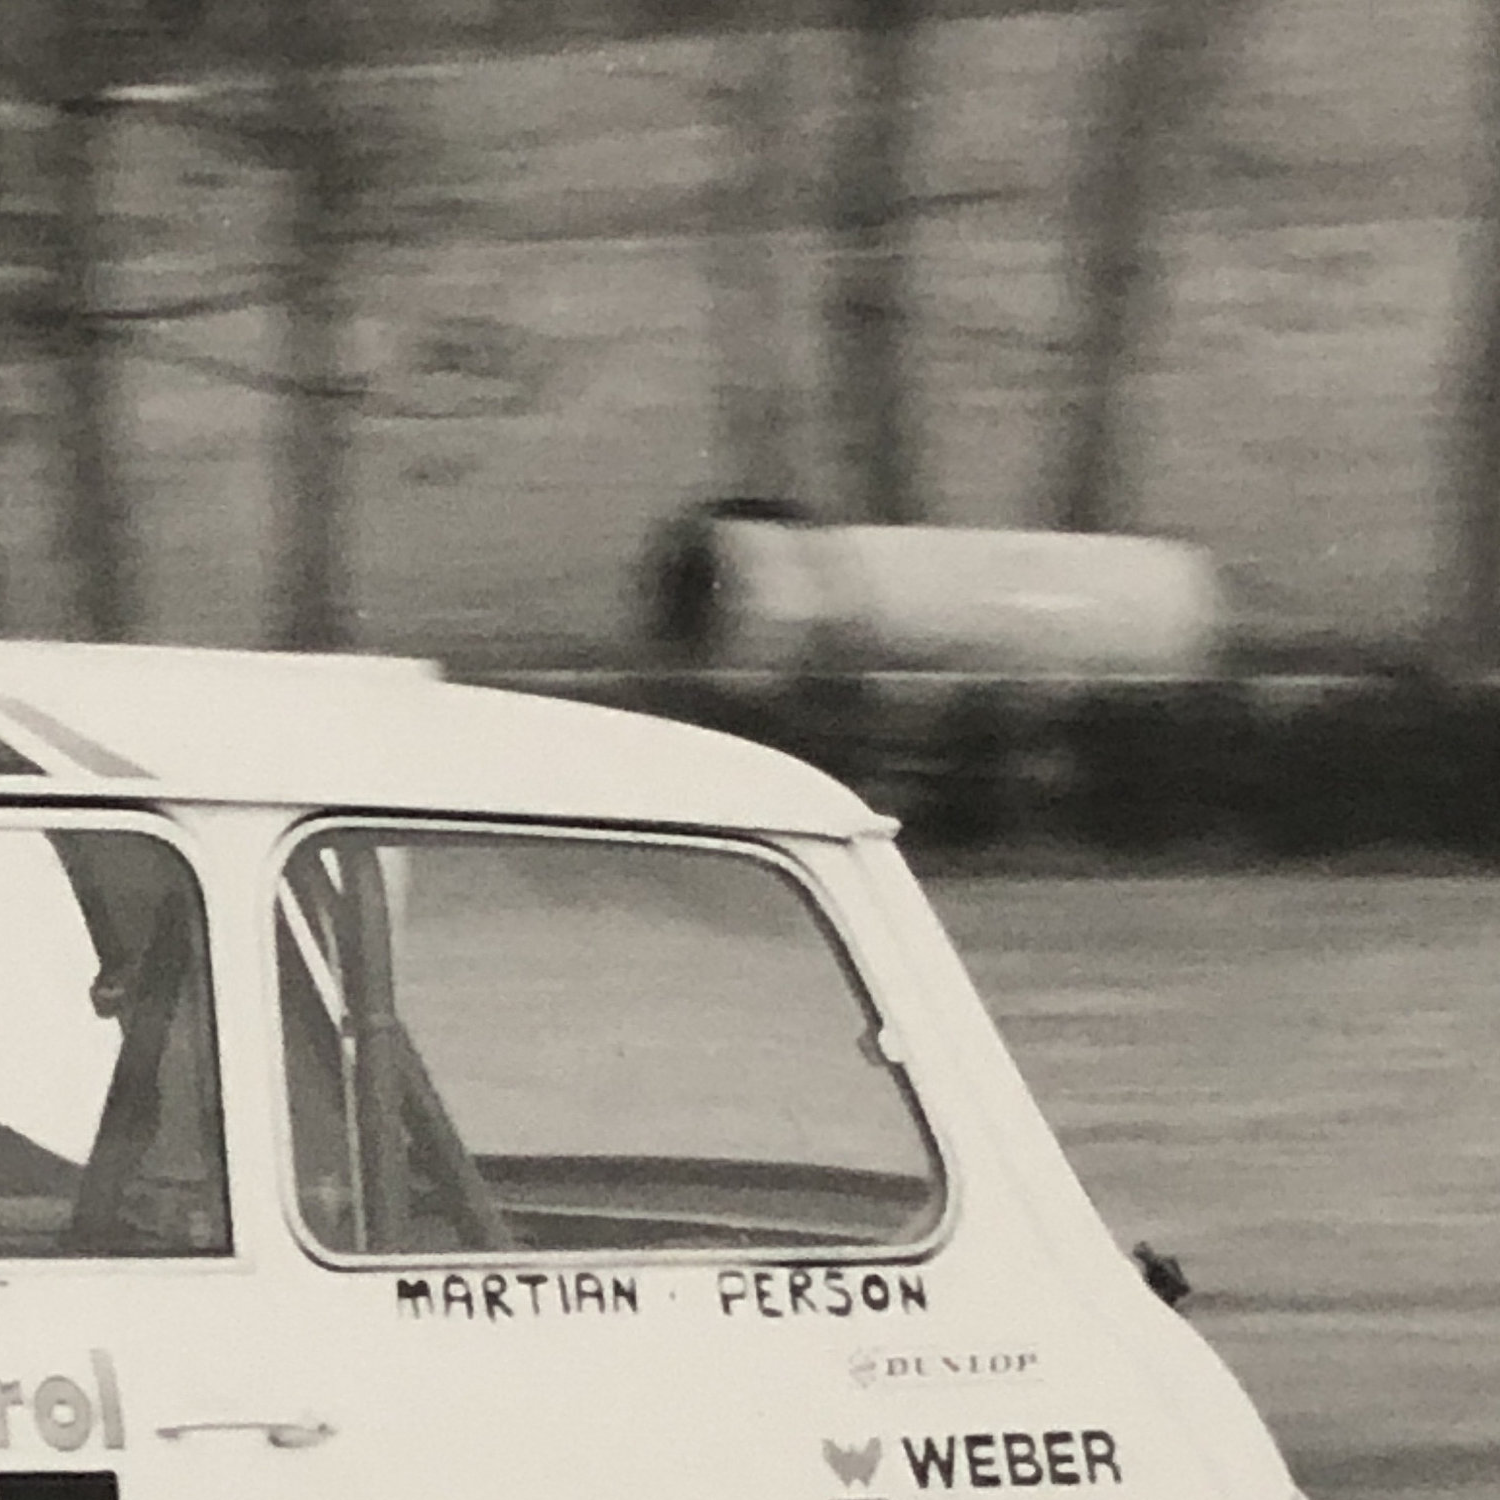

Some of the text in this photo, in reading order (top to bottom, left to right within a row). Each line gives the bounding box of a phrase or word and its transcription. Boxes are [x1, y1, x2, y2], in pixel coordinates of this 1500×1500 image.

[396, 1268, 928, 1320] MARTIAN PERSON
[883, 1353, 1040, 1377] DUNLOP
[902, 1430, 1124, 1491] WEBER
